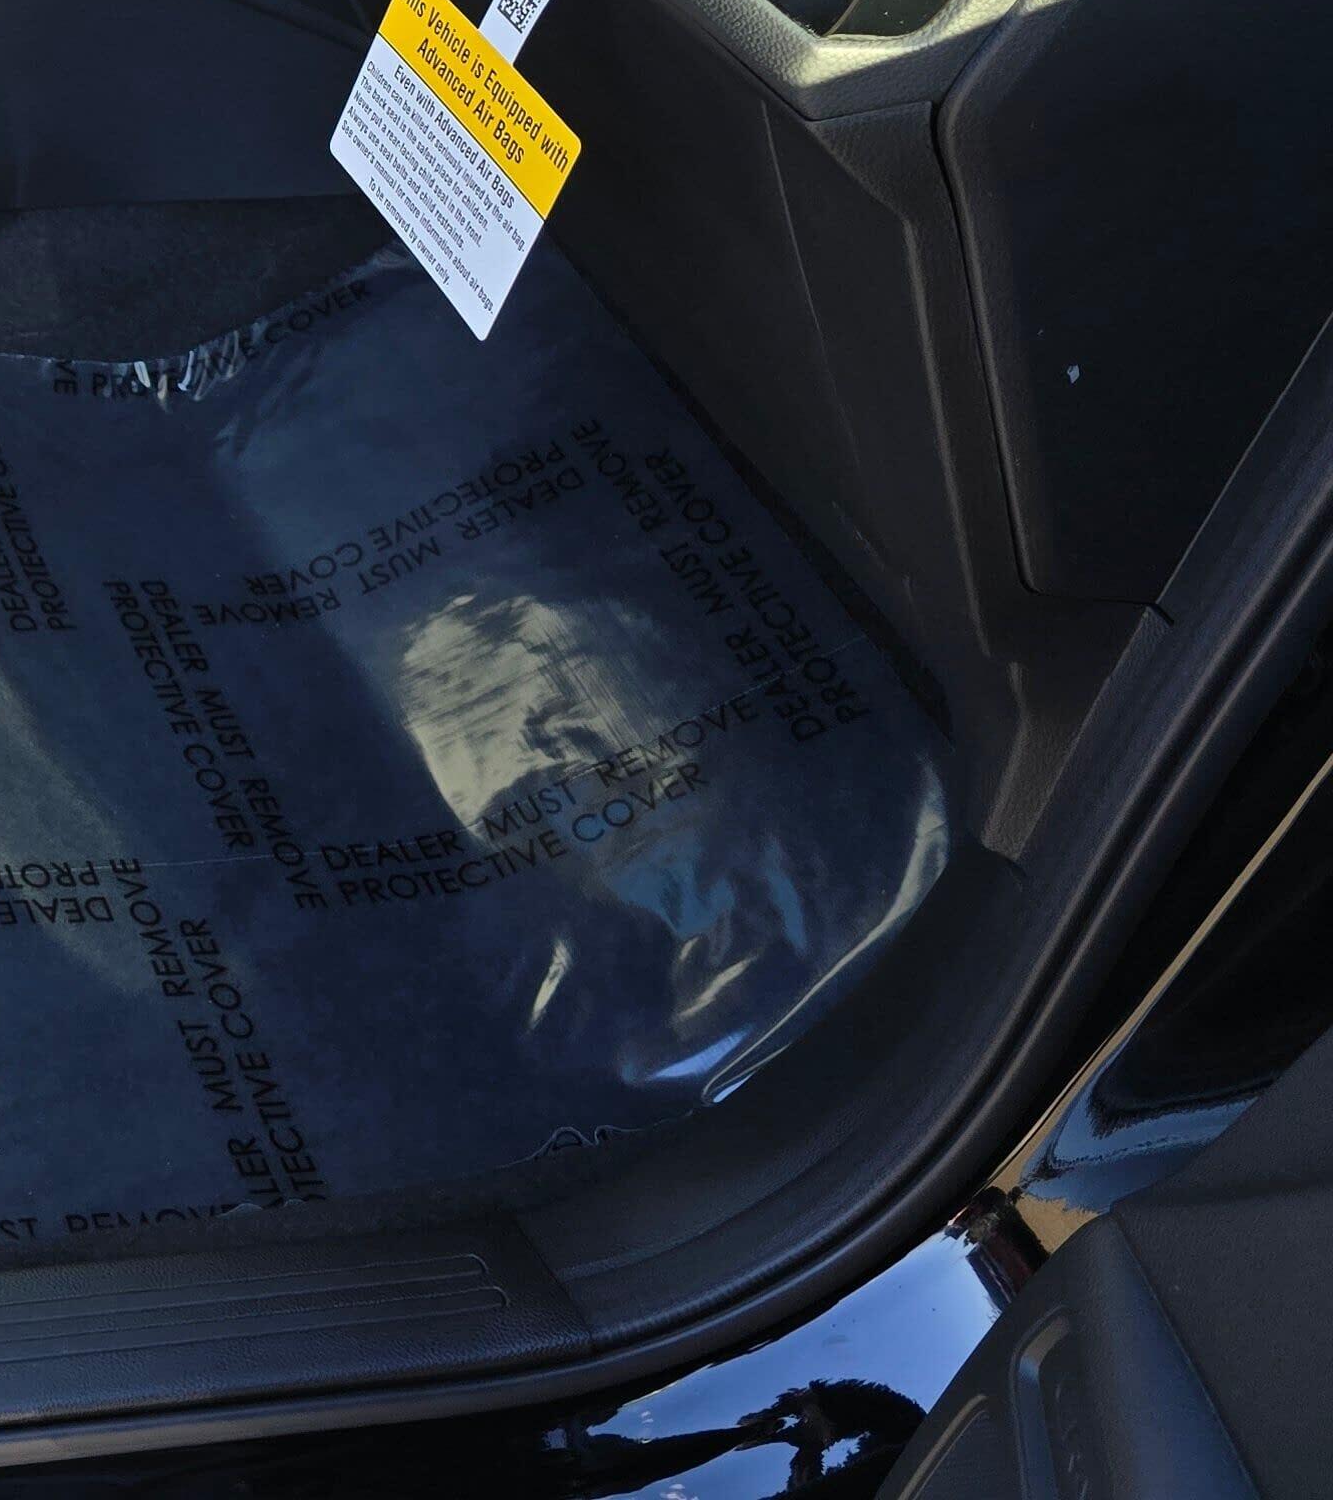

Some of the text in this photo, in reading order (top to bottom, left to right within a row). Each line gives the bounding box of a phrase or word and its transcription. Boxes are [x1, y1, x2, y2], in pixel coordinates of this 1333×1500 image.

[394, 64, 515, 209] Even with Advanced Air Bags
[416, 37, 525, 164] Advanced Air Bags
[427, 6, 471, 64] Vehicle
[470, 54, 485, 79] is
[483, 68, 543, 141] Equipped
[540, 134, 569, 173] with
[192, 466, 586, 627] DEALER MUST REMOVE
[243, 439, 568, 598] PROTECTIVE COVER
[571, 417, 828, 744] DEALER MUST REMOVE
[644, 448, 873, 726] PROTECTIVE COVER
[103, 578, 255, 850] PROTECTIVE COVER
[138, 579, 330, 911] DEALER MUST REMOVE
[319, 700, 761, 873] DEALER MUST REMOVE
[336, 760, 712, 908] PROTECTIVE COVER
[110, 856, 196, 999] REMOVE
[177, 1018, 245, 1116] MUST
[179, 916, 328, 1202] TECTIVE COVER
